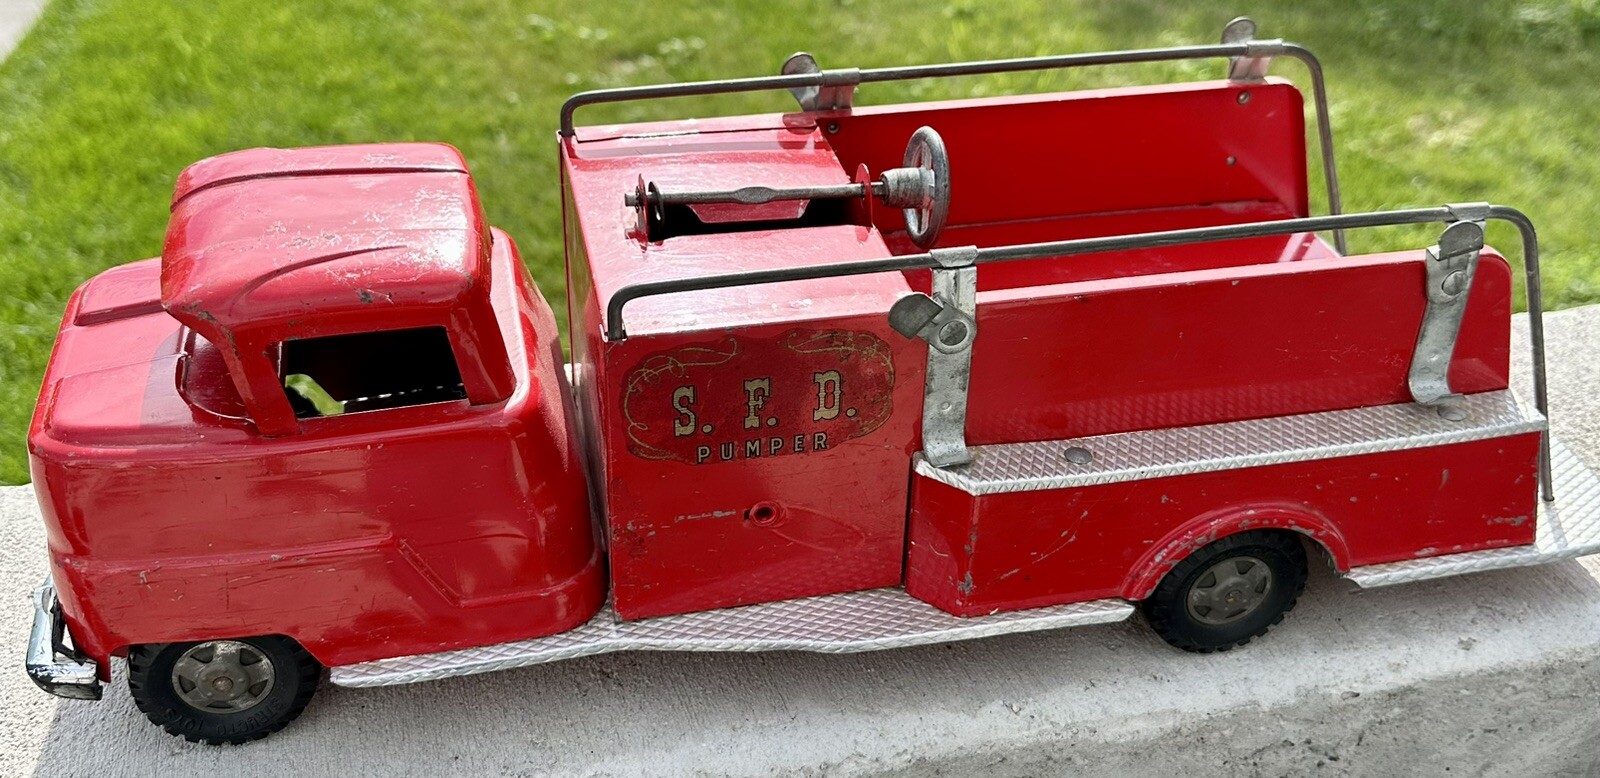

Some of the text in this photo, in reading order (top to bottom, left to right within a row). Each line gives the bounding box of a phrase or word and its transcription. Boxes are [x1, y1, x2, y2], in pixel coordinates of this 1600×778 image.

[672, 369, 858, 437] S. F. D.
[696, 432, 829, 464] PUMPER
